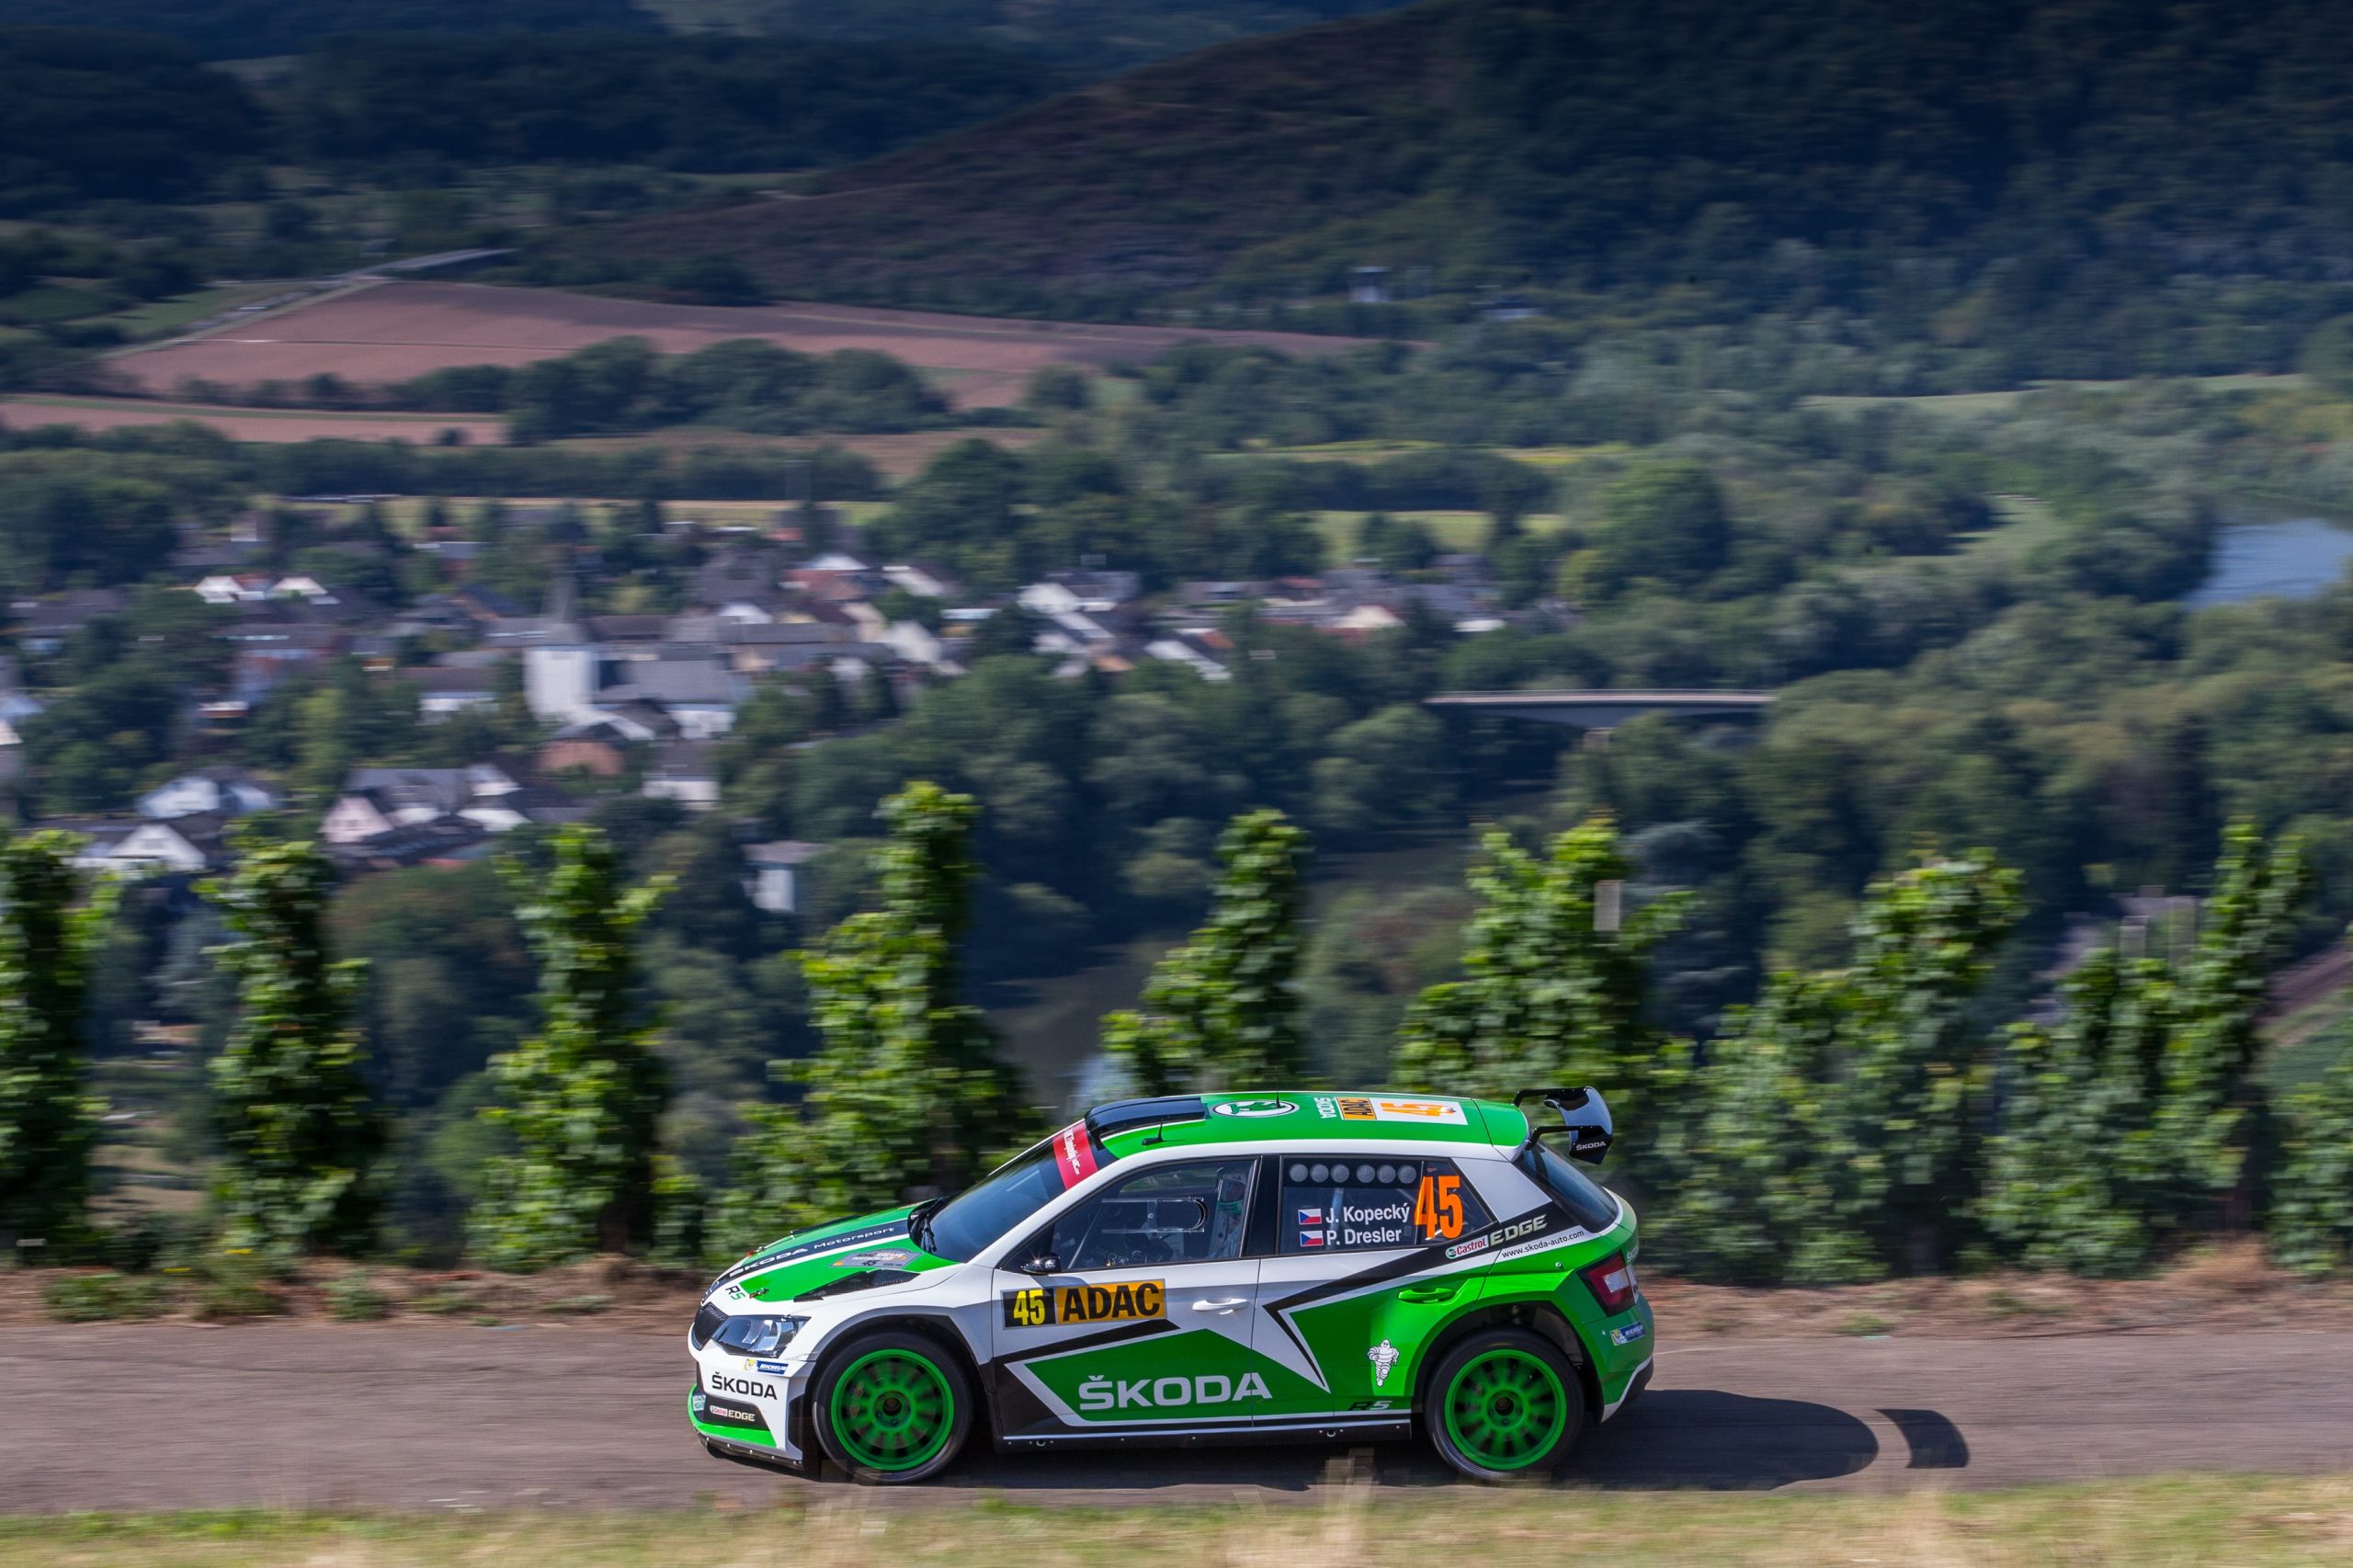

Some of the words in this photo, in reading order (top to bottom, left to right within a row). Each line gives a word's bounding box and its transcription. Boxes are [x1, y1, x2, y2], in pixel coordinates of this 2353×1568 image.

[1325, 1208, 1339, 1223] J.
[1343, 1202, 1410, 1225] Kopecký
[1414, 1175, 1463, 1240] 45
[813, 1227, 894, 1250] Motorsport
[1326, 1230, 1340, 1245] P.
[1344, 1227, 1402, 1244] Dresler
[1456, 1237, 1487, 1256] Castrol
[1489, 1213, 1548, 1247] EDGE
[1501, 1230, 1585, 1258] www.skoda-auto.com
[725, 1285, 746, 1301] R5
[1013, 1289, 1045, 1326] 45
[1063, 1282, 1160, 1323] ADAC
[711, 1371, 778, 1401] ŠKODA
[1078, 1371, 1273, 1411] ŠKODA
[728, 1409, 756, 1422] EDGE
[1347, 1400, 1393, 1411] R5
